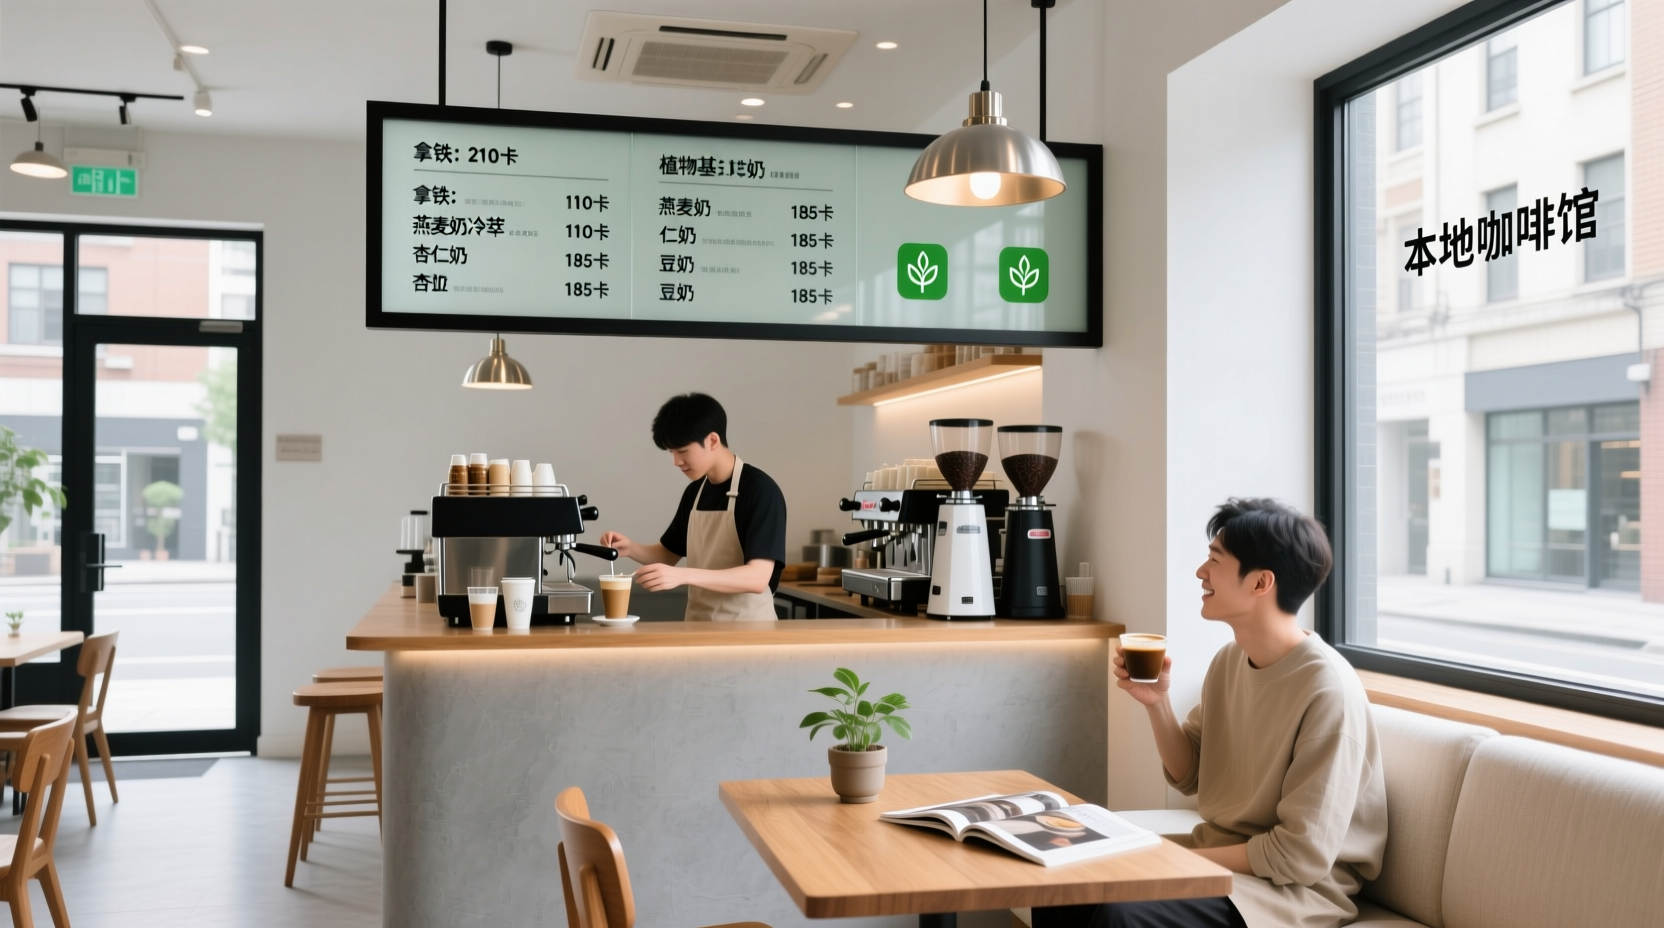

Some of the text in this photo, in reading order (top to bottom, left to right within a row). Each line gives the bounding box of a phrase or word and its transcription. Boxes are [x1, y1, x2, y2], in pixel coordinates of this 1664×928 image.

[566, 194, 610, 212] 110卡
[658, 196, 711, 217] 燕麦奶
[791, 204, 834, 221] 185卡
[413, 215, 610, 241] 燕麦奶冷萃 110卡
[659, 225, 696, 245] 仁奶
[791, 232, 834, 249] 185卡
[1404, 187, 1599, 277] 本地咖啡馆
[413, 244, 609, 269] 杏仁奶 185卡
[659, 254, 694, 274] 豆奶
[791, 260, 833, 277] 185卡
[565, 281, 609, 299] 185卡
[659, 283, 833, 305] 豆奶 185卡
